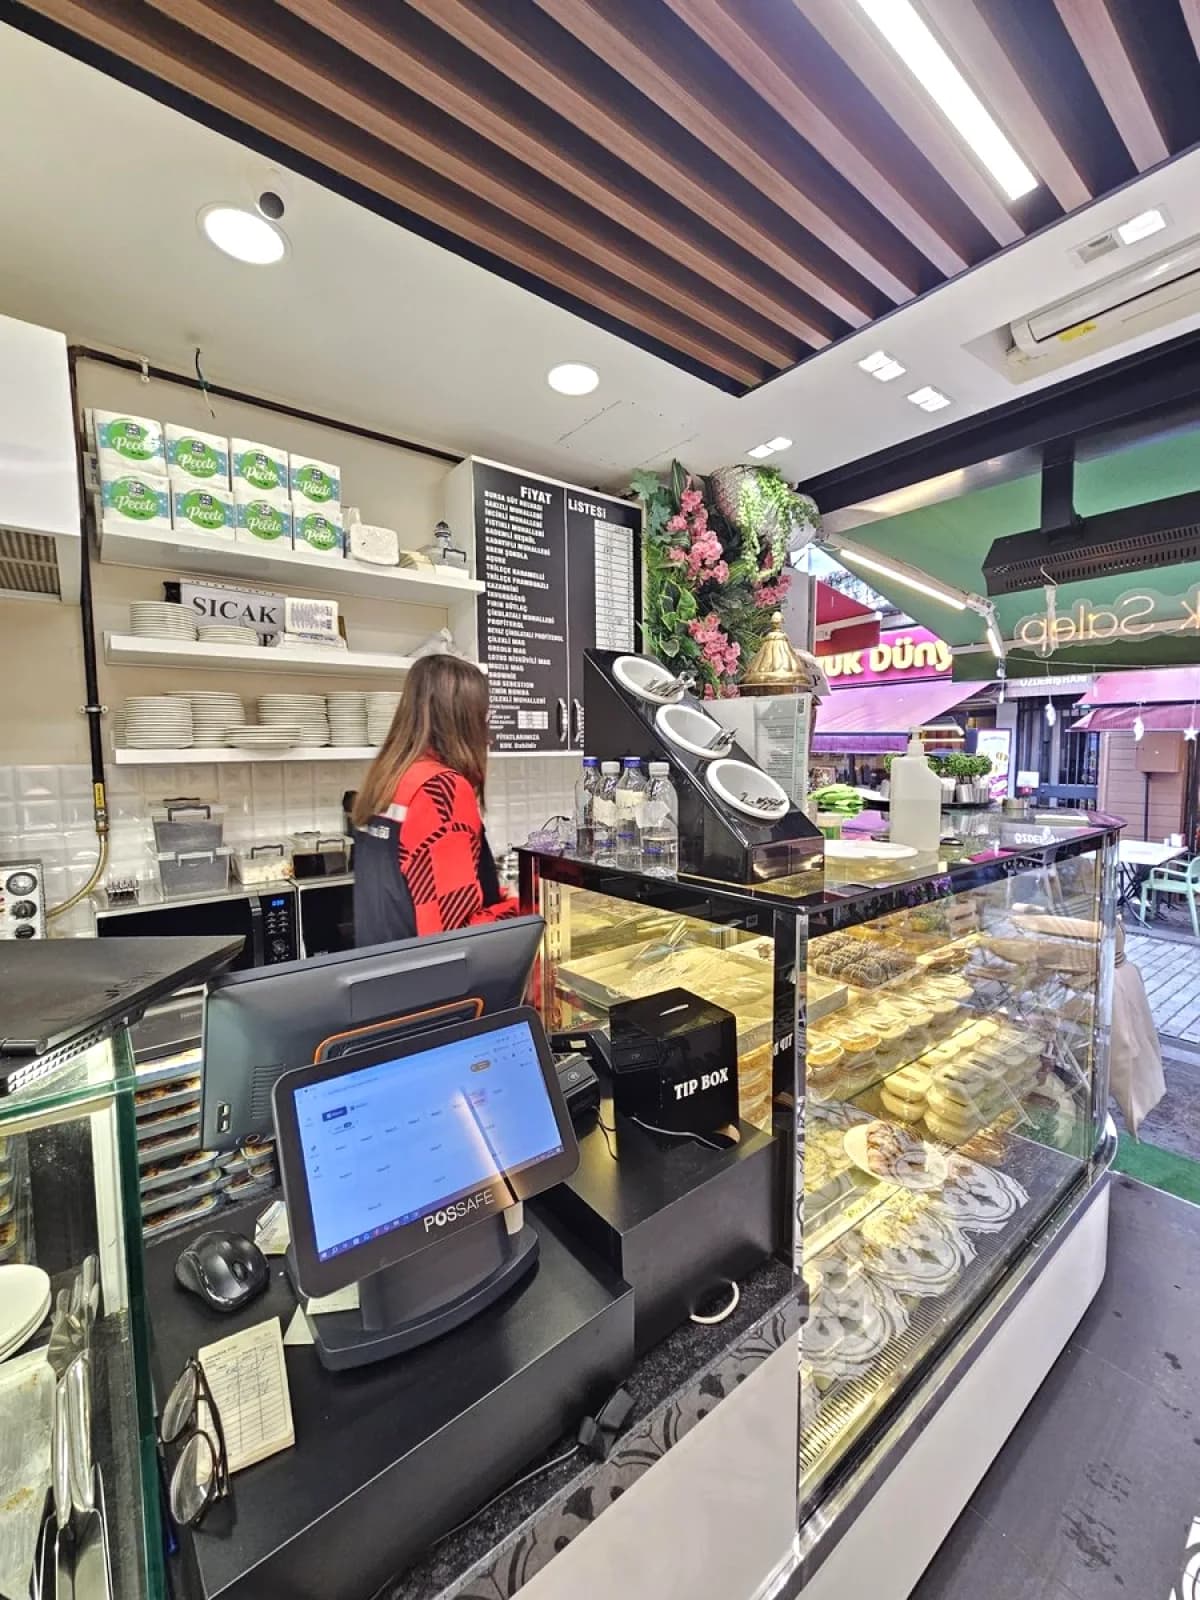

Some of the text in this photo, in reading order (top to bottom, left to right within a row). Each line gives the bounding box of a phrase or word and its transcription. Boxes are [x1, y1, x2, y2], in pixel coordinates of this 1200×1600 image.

[192, 596, 277, 624] SICAK
[674, 1067, 729, 1100] TIP BOX
[423, 1190, 495, 1233] POSSAFE
